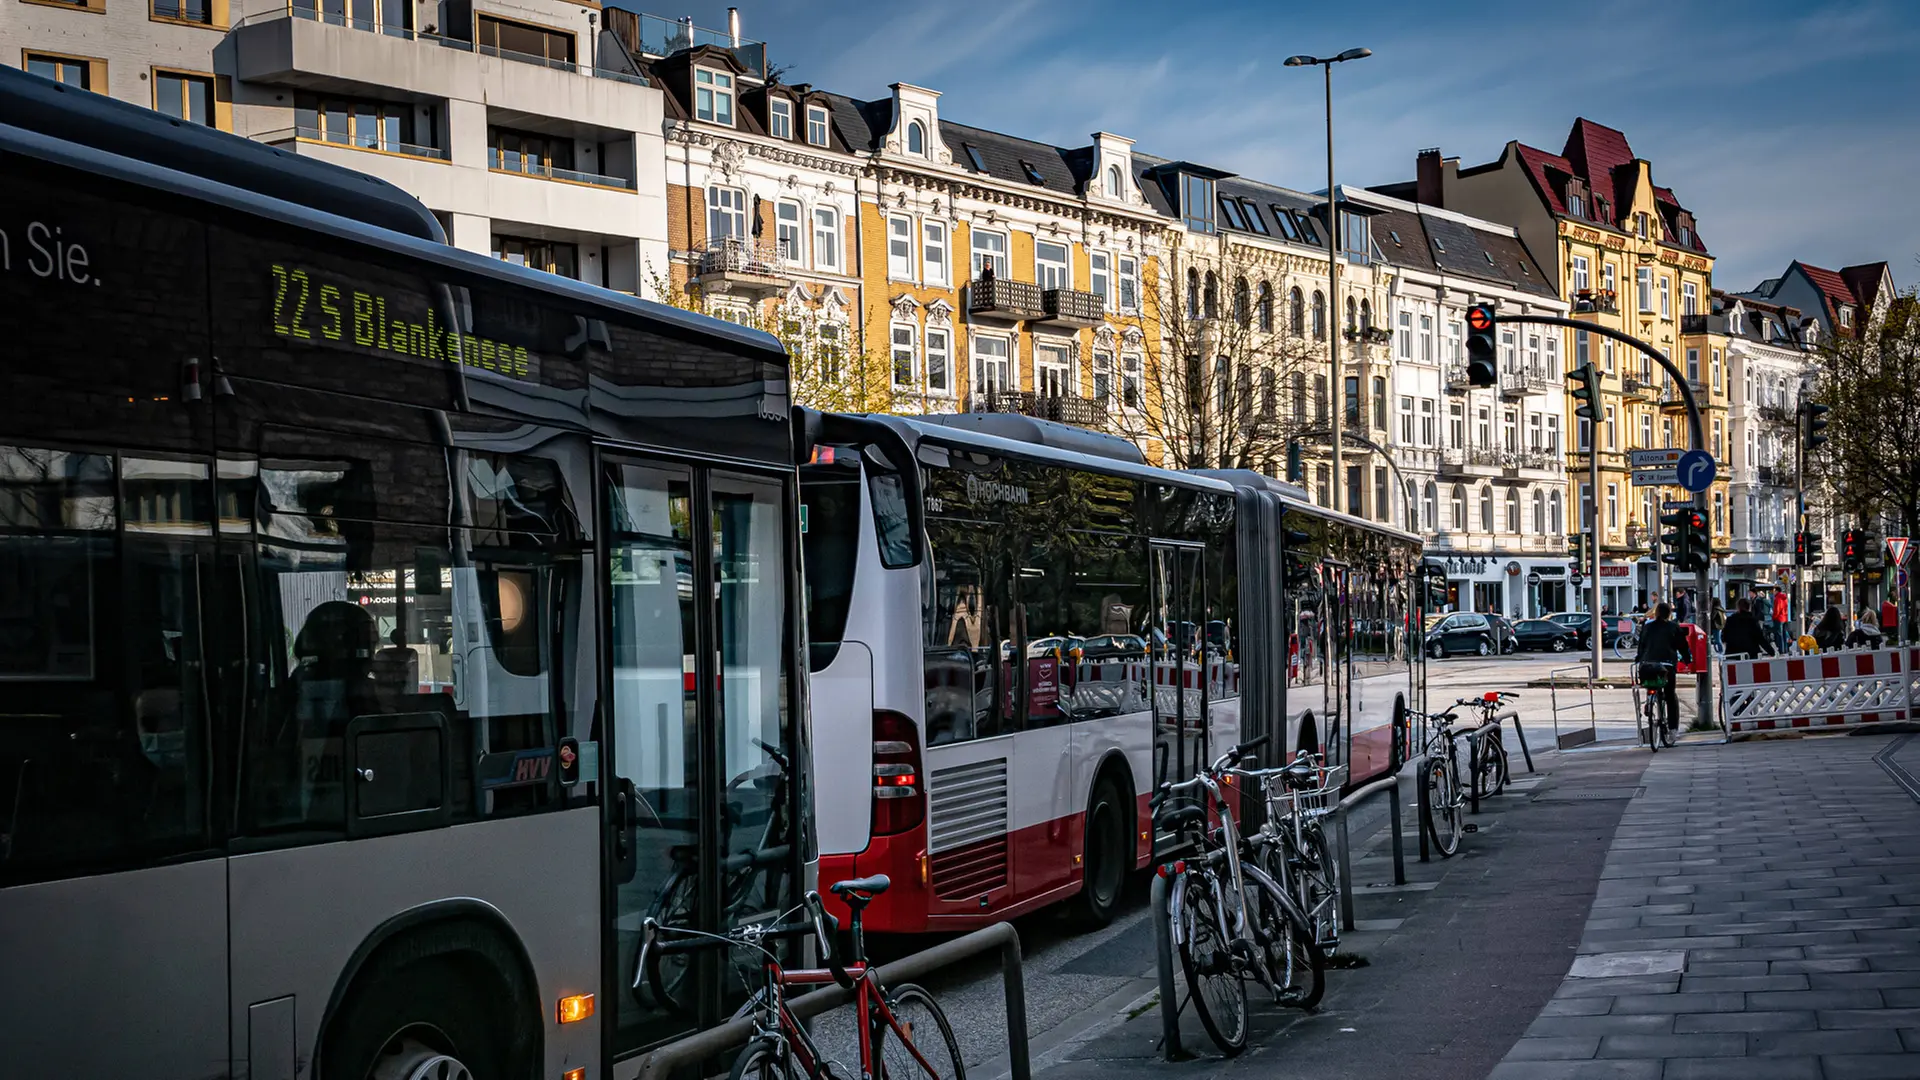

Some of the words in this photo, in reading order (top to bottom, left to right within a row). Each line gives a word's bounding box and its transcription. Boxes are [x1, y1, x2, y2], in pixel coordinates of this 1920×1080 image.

[27, 221, 101, 287] Sie.
[272, 264, 311, 339] 22
[319, 283, 342, 340] S
[353, 291, 528, 376] Blankenese
[1639, 454, 1664, 462] Altona
[979, 480, 1029, 504] HOCHBAHN
[926, 496, 943, 513] 7862
[515, 756, 552, 781] HVV
